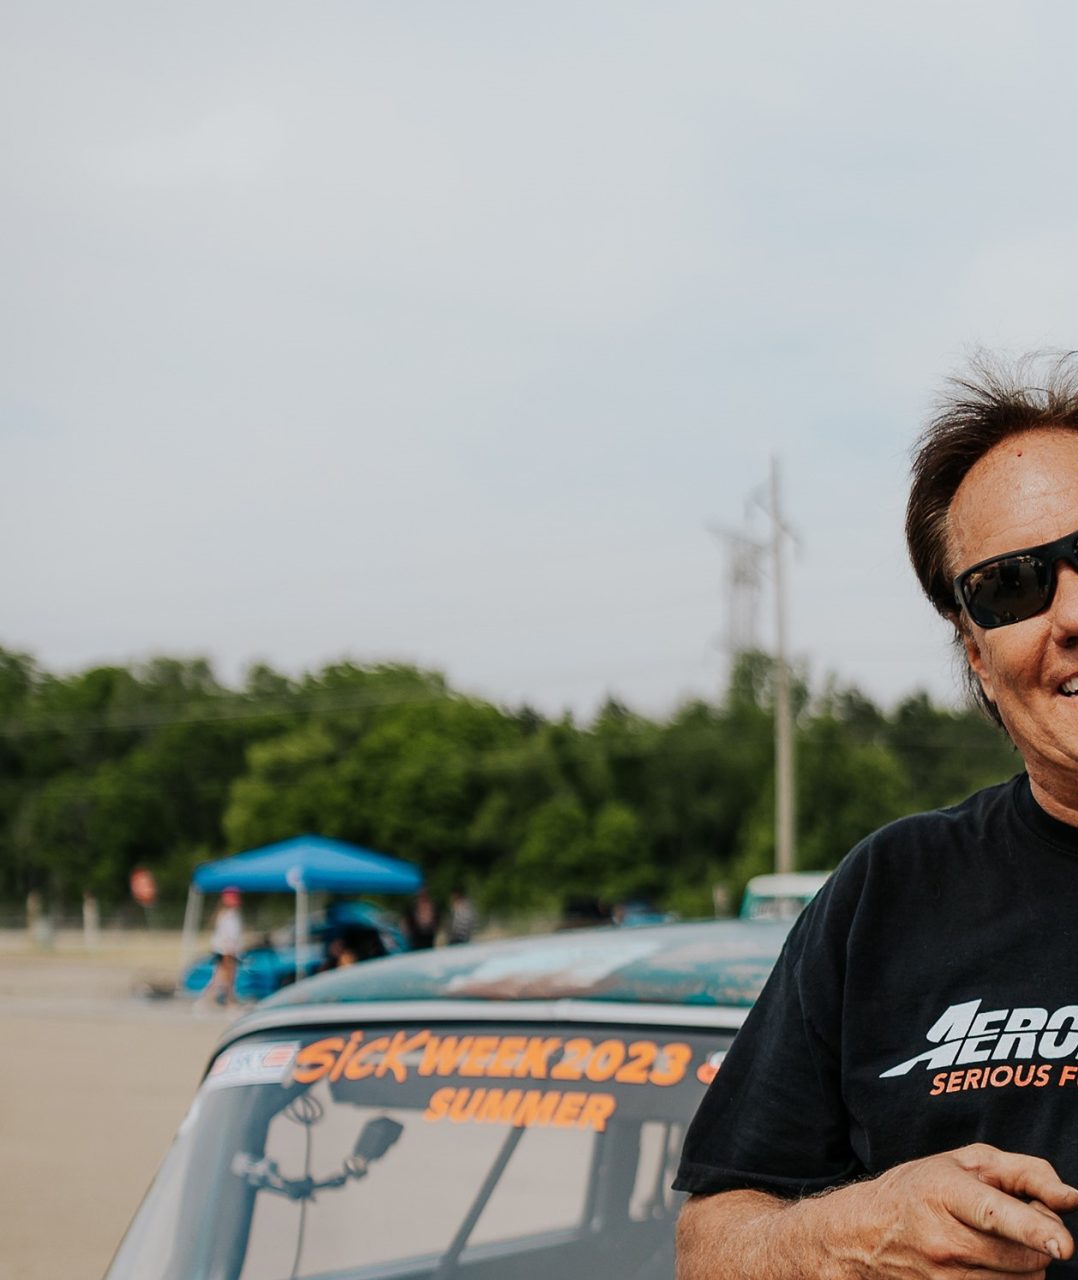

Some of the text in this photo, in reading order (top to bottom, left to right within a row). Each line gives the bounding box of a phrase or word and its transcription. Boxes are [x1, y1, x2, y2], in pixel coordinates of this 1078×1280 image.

[417, 1036, 566, 1079] WEEK
[550, 1038, 693, 1086] 2023
[930, 1064, 1053, 1096] SERIOUS
[423, 1087, 617, 1132] SUMMER
